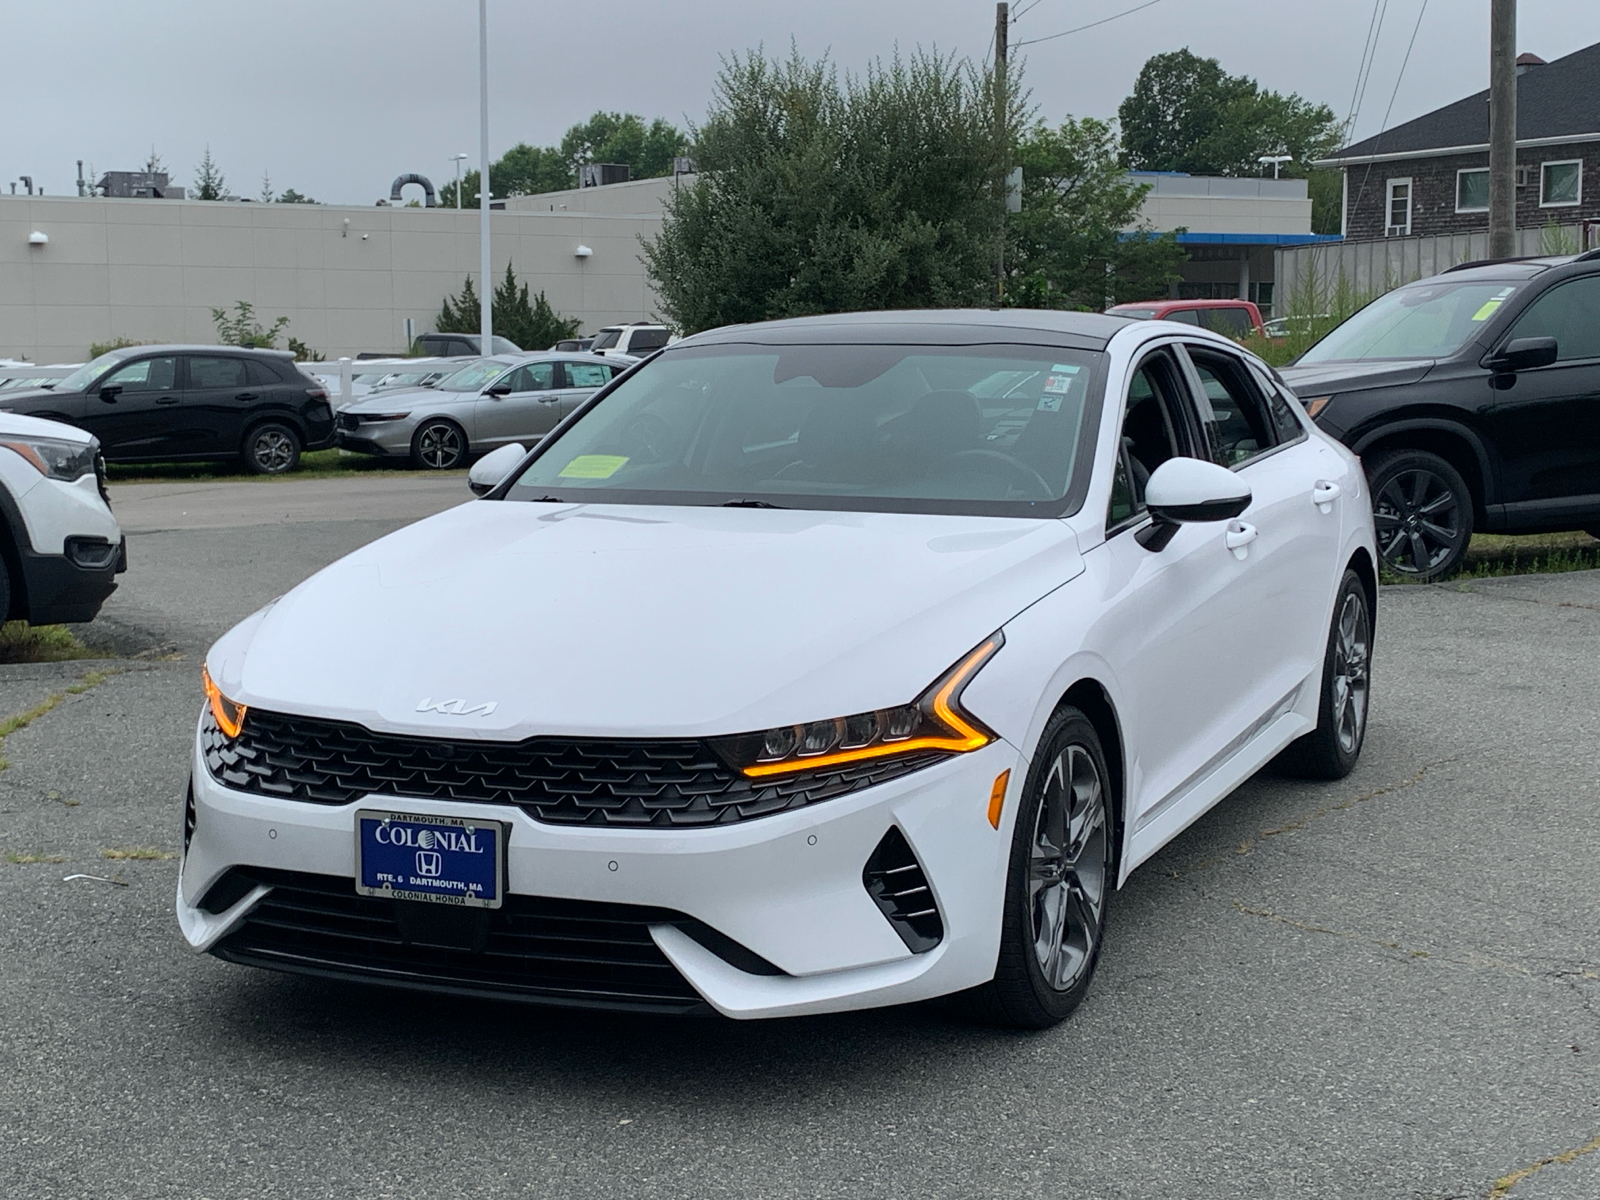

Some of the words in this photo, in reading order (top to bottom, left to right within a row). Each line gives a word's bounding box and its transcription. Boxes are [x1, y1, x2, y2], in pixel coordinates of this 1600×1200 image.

[450, 819, 465, 827] MA
[375, 825, 484, 854] COLONIAL
[376, 872, 396, 883] RTE.
[397, 875, 404, 883] 6
[409, 876, 467, 891] DARTMOUTH,
[469, 882, 483, 892] MA
[391, 890, 433, 902] COLONIAL
[435, 894, 466, 905] HONDA
